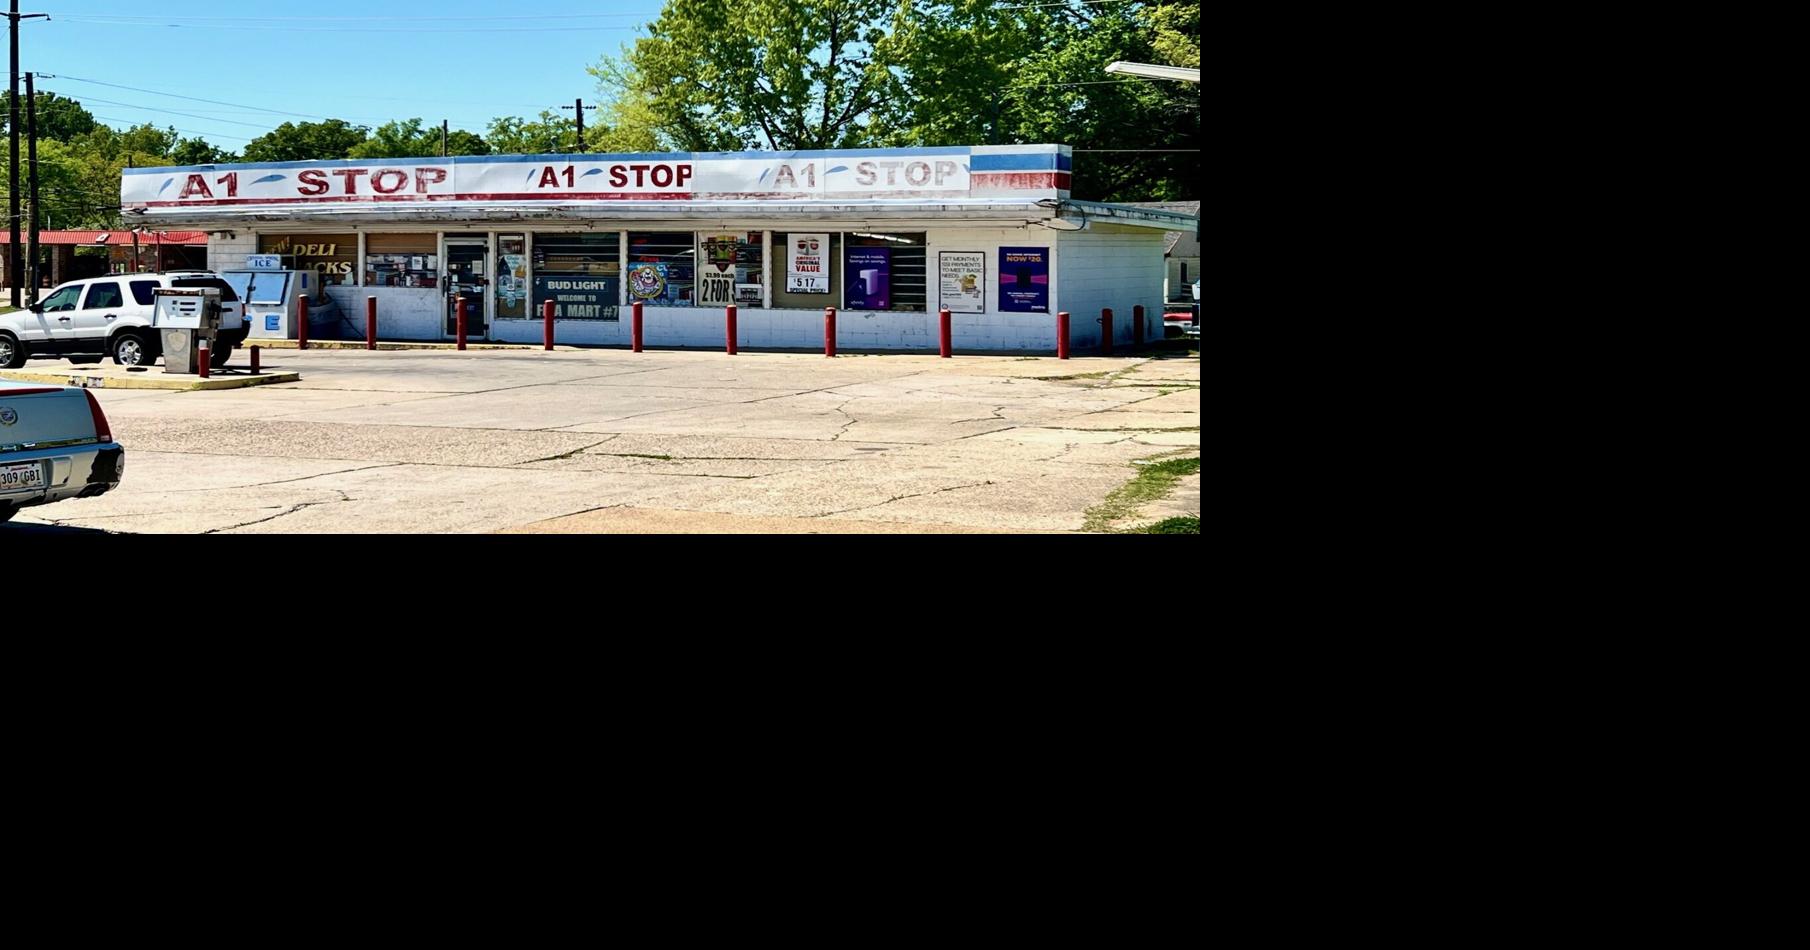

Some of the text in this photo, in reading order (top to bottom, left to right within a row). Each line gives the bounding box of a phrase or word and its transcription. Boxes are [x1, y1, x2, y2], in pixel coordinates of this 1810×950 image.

[179, 168, 447, 199] A1 STOP
[538, 164, 692, 188] A1 STOP
[773, 160, 958, 188] A1 STOP
[293, 243, 337, 256] DELI
[547, 281, 606, 290] BUD LIGHT
[702, 279, 709, 302] 2
[710, 279, 730, 302] FOR
[567, 304, 601, 317] MART
[603, 305, 619, 318] #7
[1, 469, 40, 485] 309 GBI
